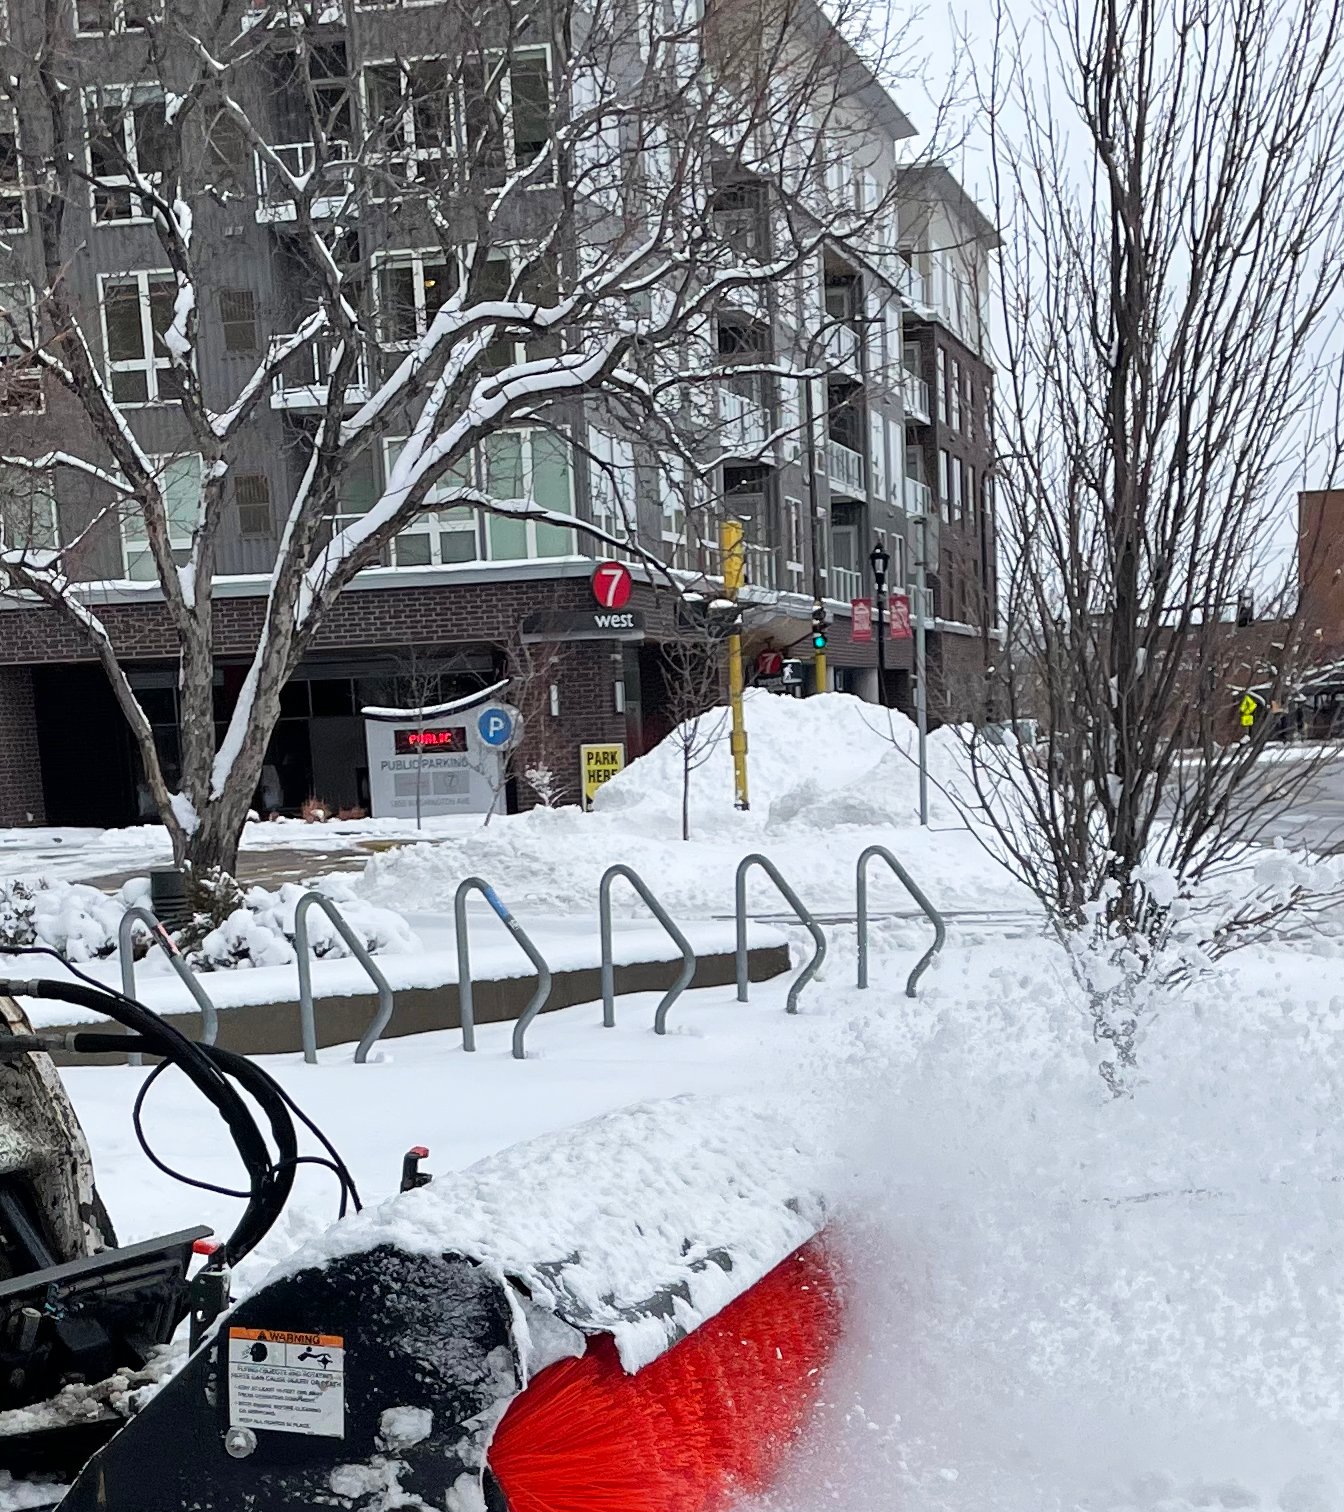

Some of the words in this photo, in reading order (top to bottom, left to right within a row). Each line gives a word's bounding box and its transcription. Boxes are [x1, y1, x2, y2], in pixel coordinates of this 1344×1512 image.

[601, 569, 623, 607] 7
[594, 613, 634, 628] west
[489, 717, 504, 737] P
[408, 732, 452, 745] PUBLIC
[381, 759, 419, 771] PUBLIC
[422, 757, 469, 769] PARKING
[587, 751, 618, 766] PARK
[270, 1331, 320, 1345] WARNING
